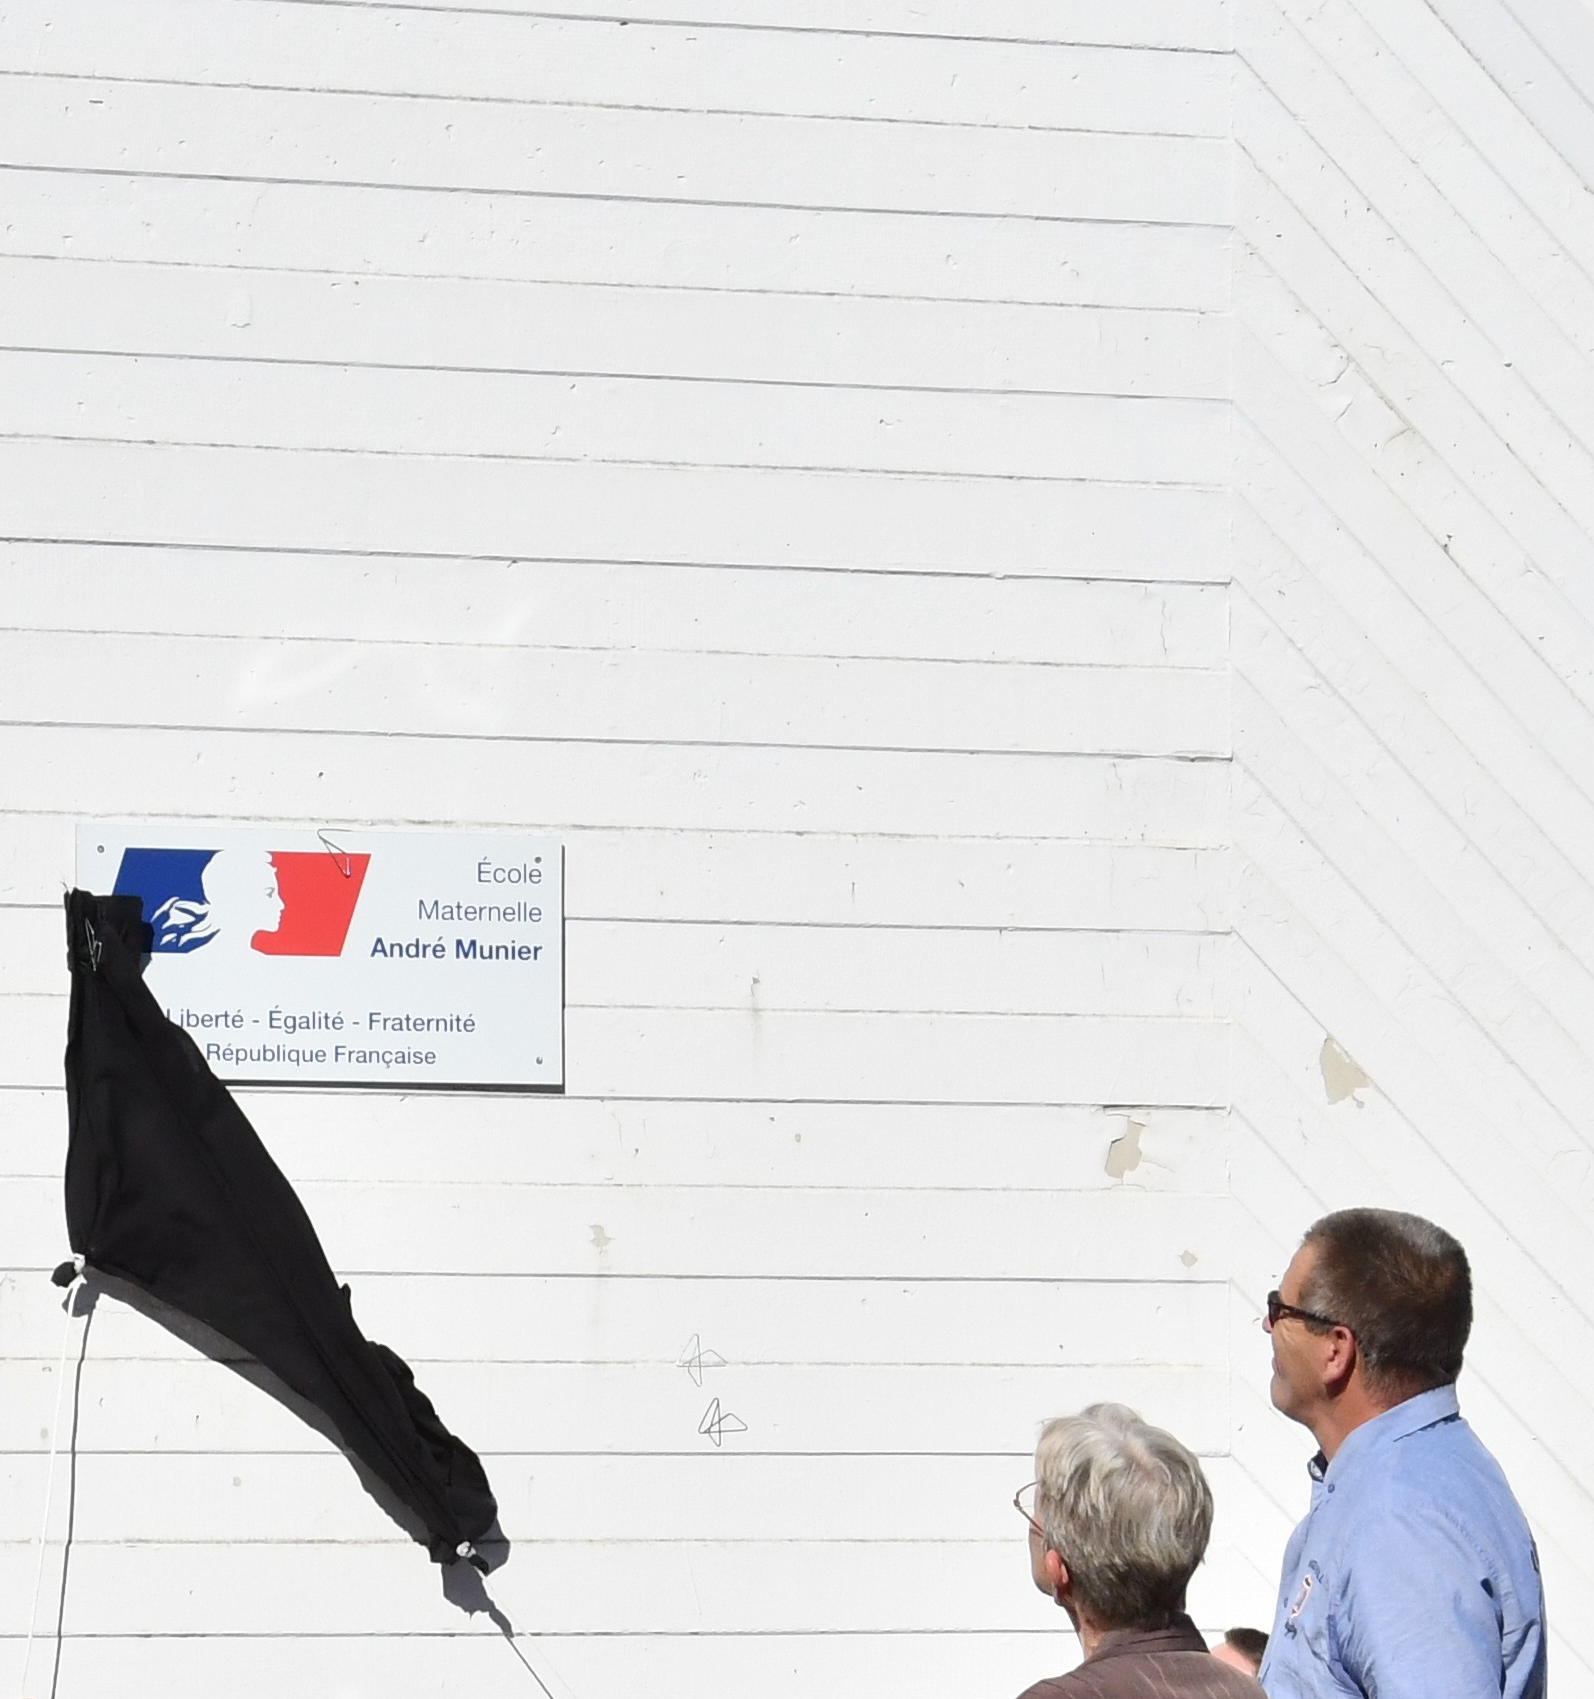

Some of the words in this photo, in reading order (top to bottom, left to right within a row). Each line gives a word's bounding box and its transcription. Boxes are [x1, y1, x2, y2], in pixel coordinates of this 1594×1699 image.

[477, 856, 542, 884] École
[418, 899, 542, 922] Maternelle
[370, 936, 446, 959] André
[455, 938, 543, 961] Munier
[268, 1005, 344, 1034] Égalité
[368, 1012, 476, 1033] Fraternité
[206, 1043, 327, 1066] République
[334, 1045, 437, 1069] Française
